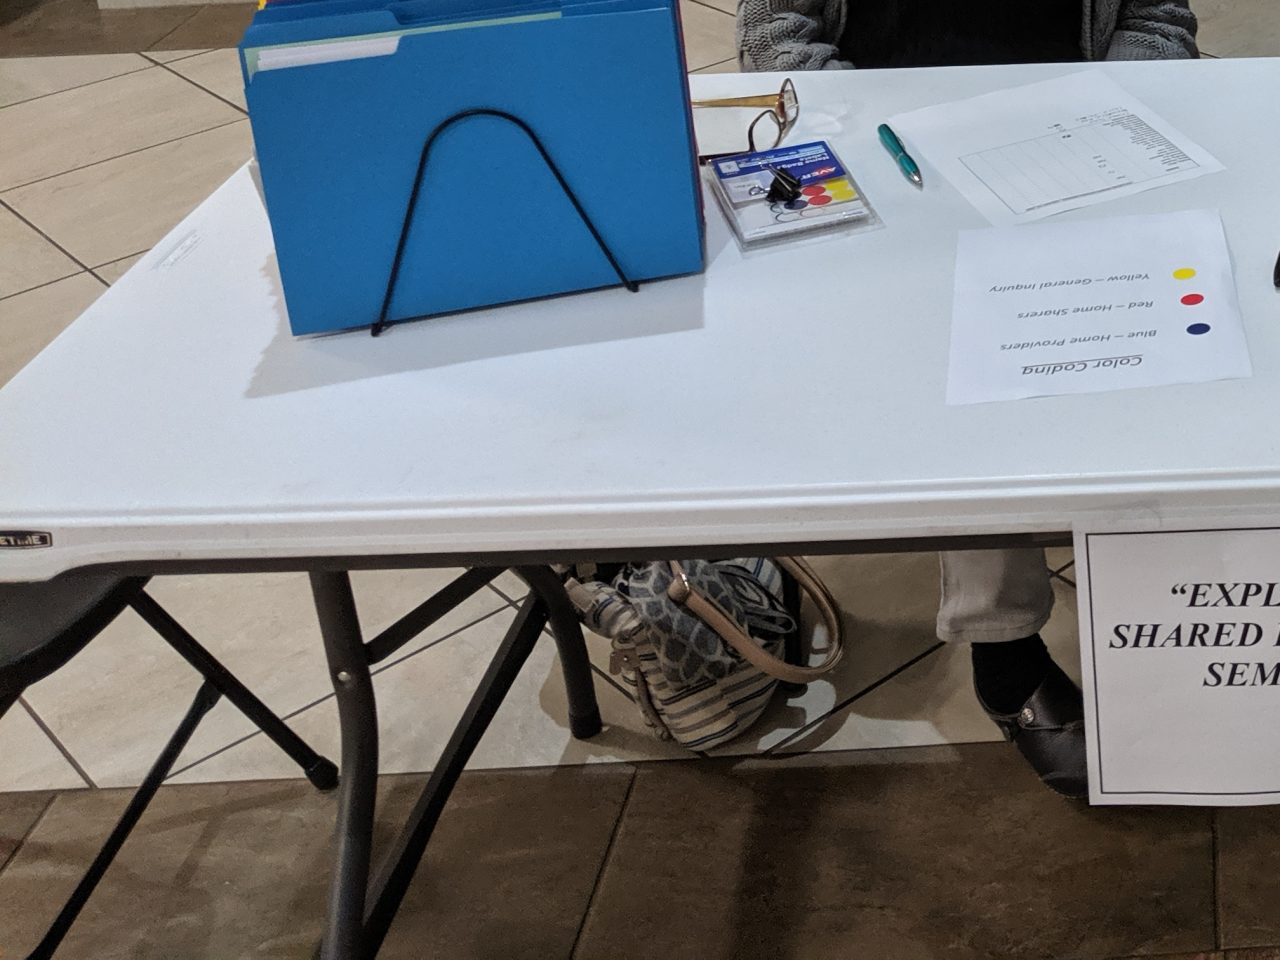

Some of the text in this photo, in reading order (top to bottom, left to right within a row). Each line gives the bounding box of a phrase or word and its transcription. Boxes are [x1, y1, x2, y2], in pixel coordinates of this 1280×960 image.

[798, 166, 837, 180] AVER
[1039, 277, 1093, 287] General
[1106, 272, 1151, 282] Yellow
[989, 283, 1036, 293] Inquiry
[1071, 303, 1113, 314] Home
[1127, 300, 1154, 310] Red
[1017, 307, 1070, 319] Sharers
[1069, 333, 1112, 344] Home
[1127, 329, 1158, 338] Blue
[1000, 338, 1066, 351] Providers
[1021, 355, 1143, 376] Color Coding
[1108, 622, 1264, 649] SHARED
